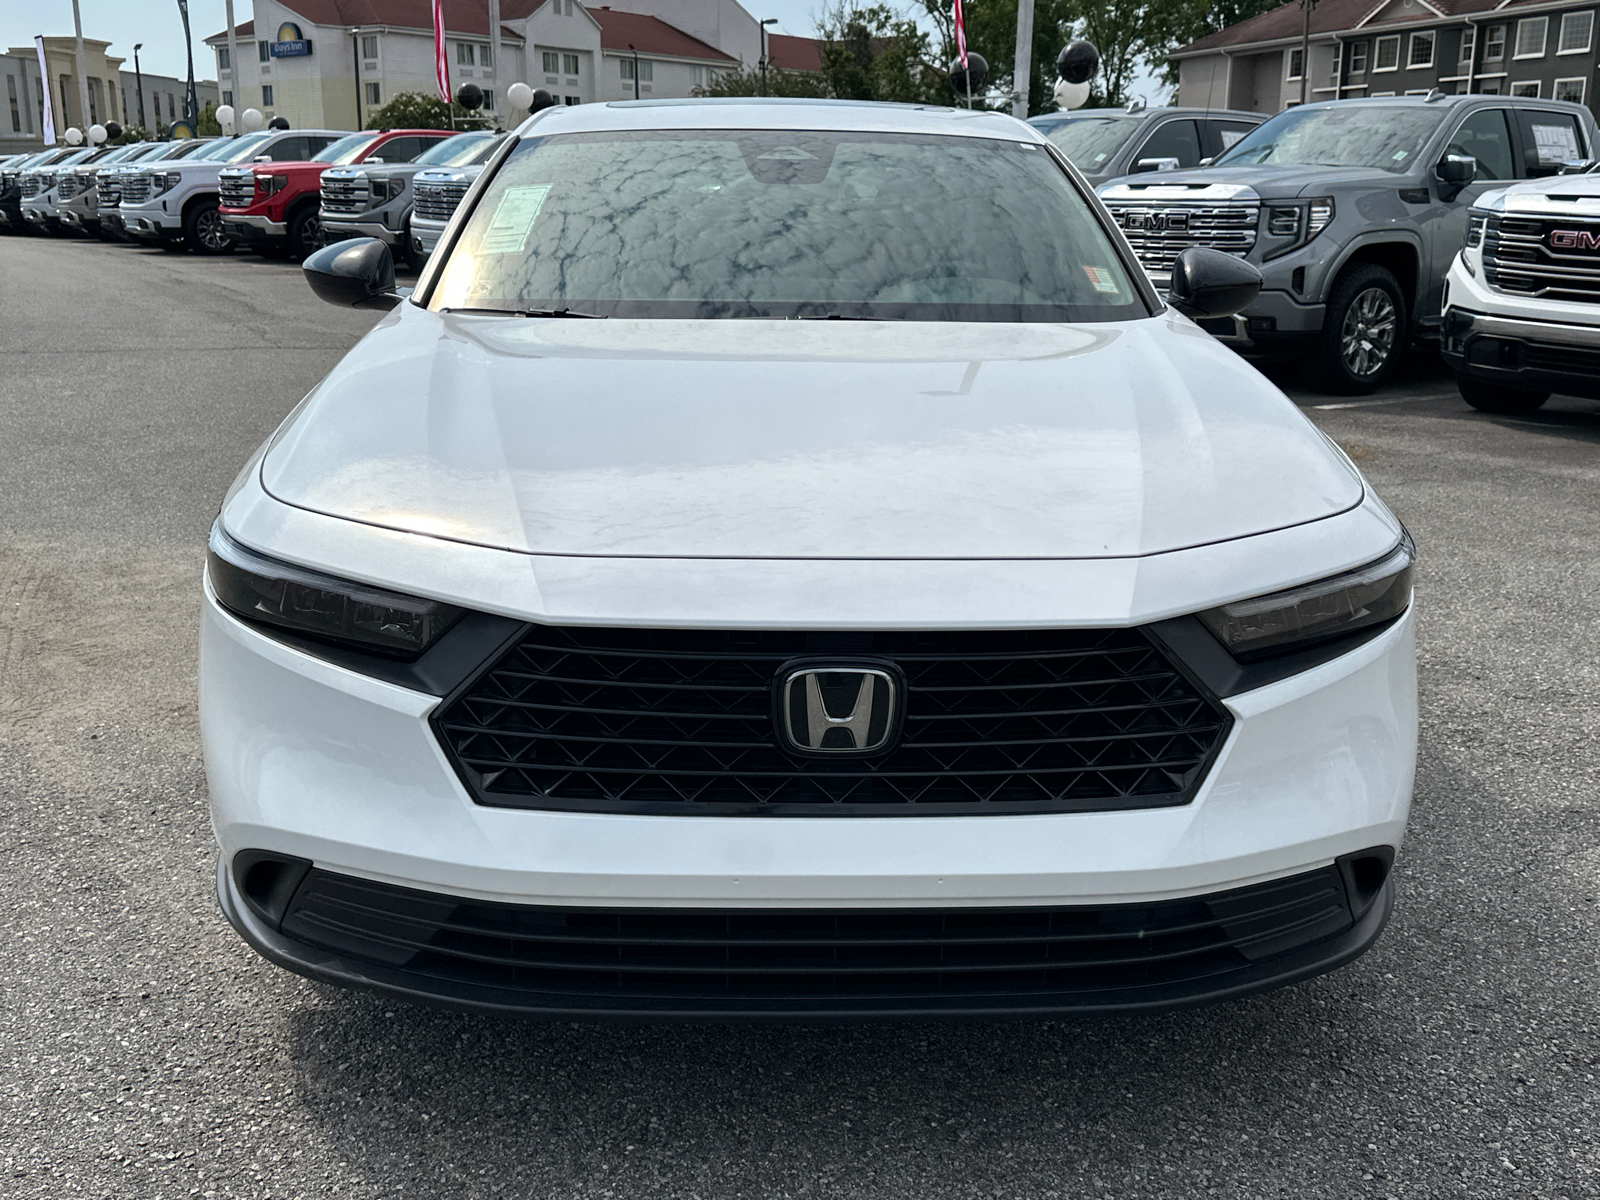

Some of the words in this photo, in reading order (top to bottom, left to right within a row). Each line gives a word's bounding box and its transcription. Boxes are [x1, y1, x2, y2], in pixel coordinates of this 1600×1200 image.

[274, 43, 290, 53] Days
[290, 42, 303, 51] Inn
[1126, 213, 1188, 230] GMC
